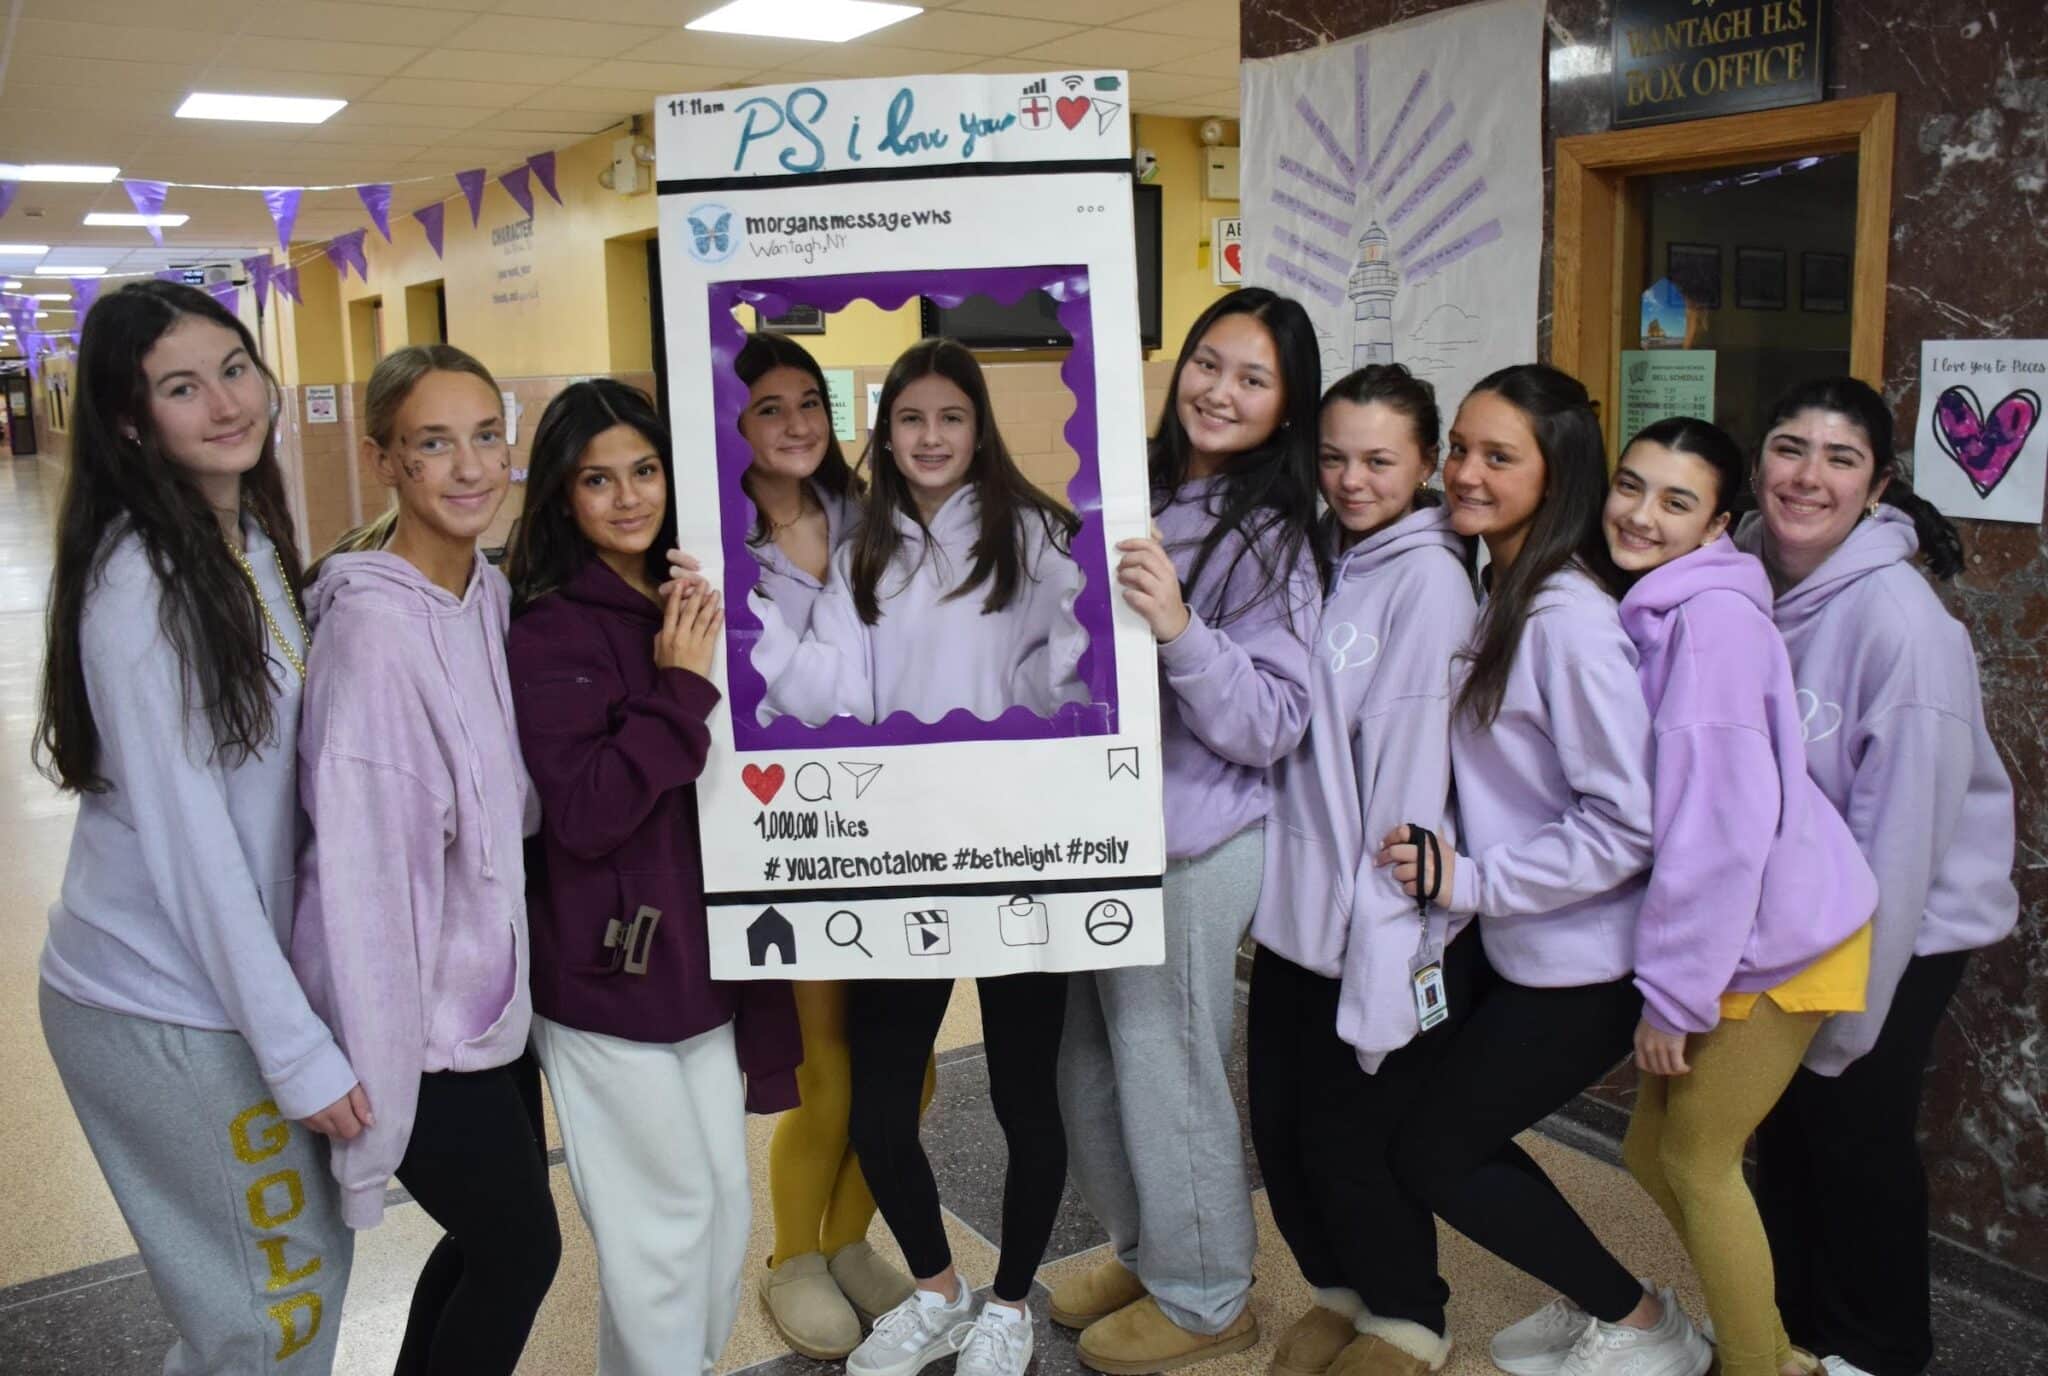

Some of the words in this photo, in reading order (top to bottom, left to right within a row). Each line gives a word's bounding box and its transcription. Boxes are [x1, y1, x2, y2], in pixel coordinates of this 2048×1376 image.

[1626, 6, 1753, 58] WANTAGH
[1762, 0, 1807, 36] H.S.
[1626, 62, 1687, 106] BOX
[1692, 42, 1806, 96] OFFICE
[668, 98, 725, 117] 11:11am
[733, 87, 828, 173] PS
[848, 115, 862, 161] i
[878, 87, 948, 156] love
[1942, 357, 1966, 373] love
[1970, 360, 1993, 375] you
[824, 810, 870, 839] likes
[952, 841, 1063, 872] #bethelight
[1066, 835, 1130, 864] #psily
[228, 1098, 323, 1363] GOLD
